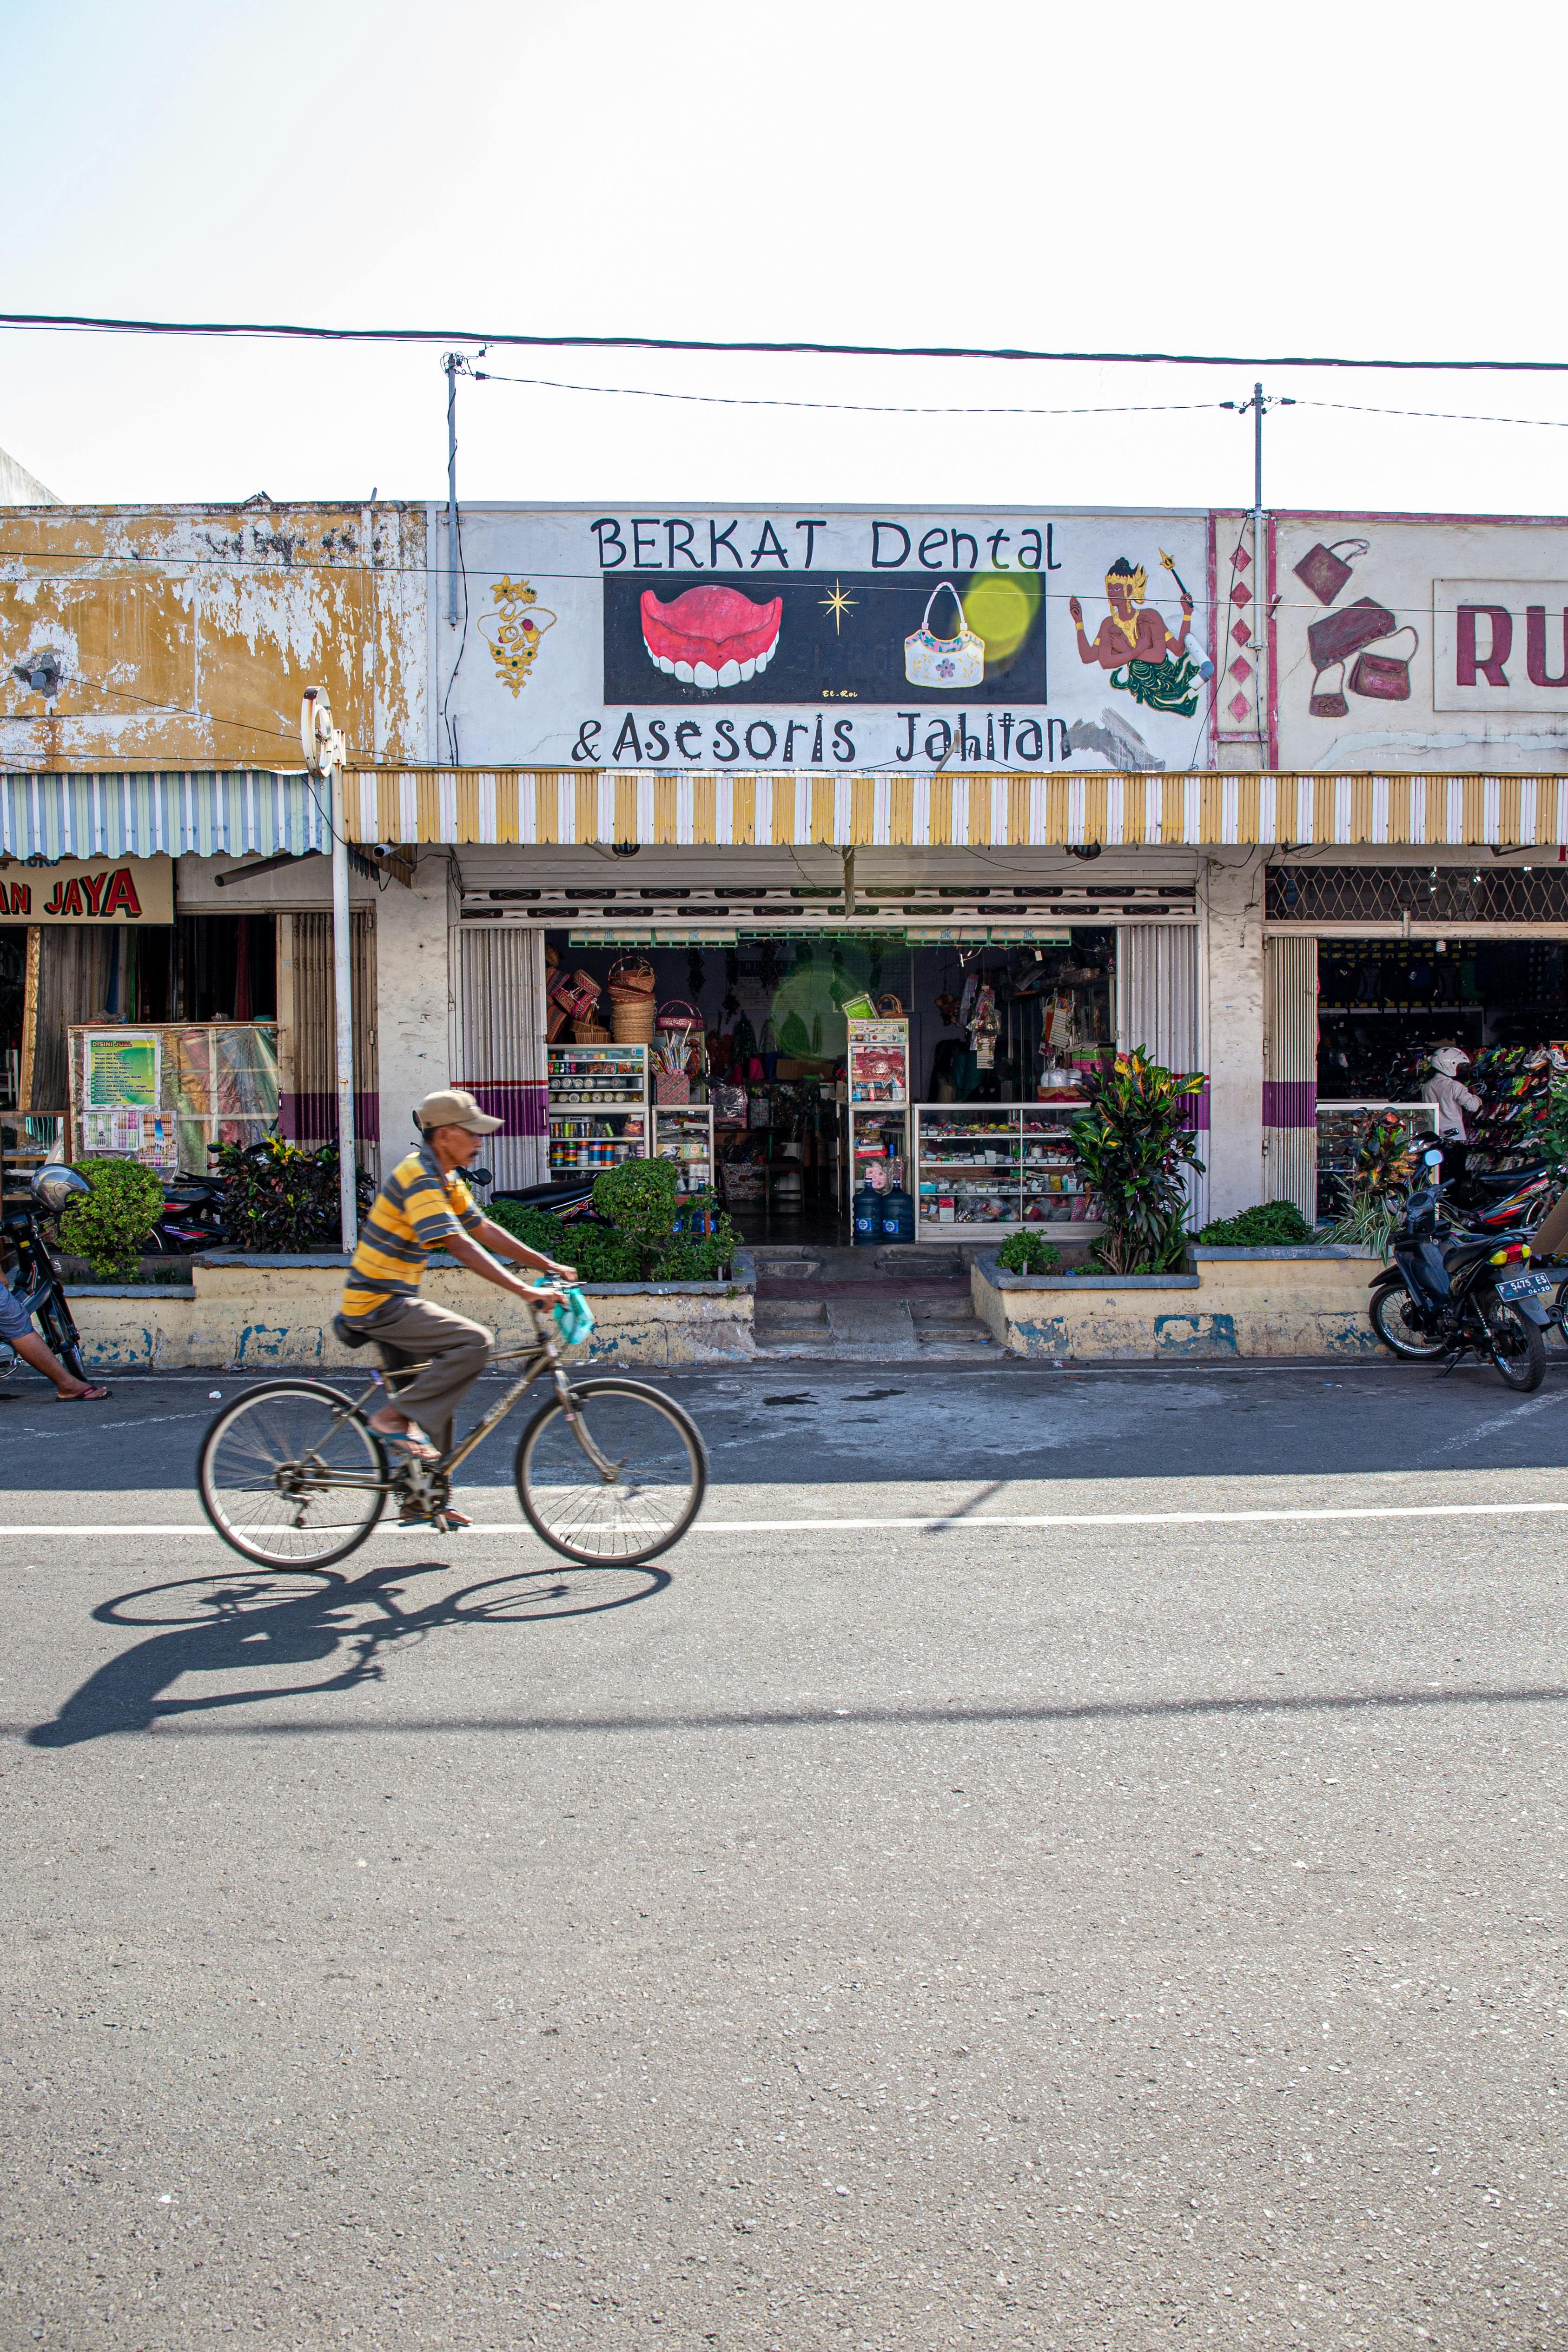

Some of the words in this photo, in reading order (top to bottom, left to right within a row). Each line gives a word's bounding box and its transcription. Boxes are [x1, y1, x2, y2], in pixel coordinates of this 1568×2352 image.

[590, 518, 827, 569] BERKAT
[871, 520, 1062, 570] Dental
[571, 720, 602, 762] &
[612, 712, 855, 762] Asesoris
[896, 712, 1072, 762] Jahitan
[43, 867, 143, 918] JAYA
[603, 931, 615, 940] ZINC
[688, 931, 700, 940] ZINC
[940, 930, 952, 939] ZINC
[1023, 930, 1035, 939] ZINC
[1510, 1279, 1531, 1290] 5475
[1535, 1275, 1547, 1285] ES
